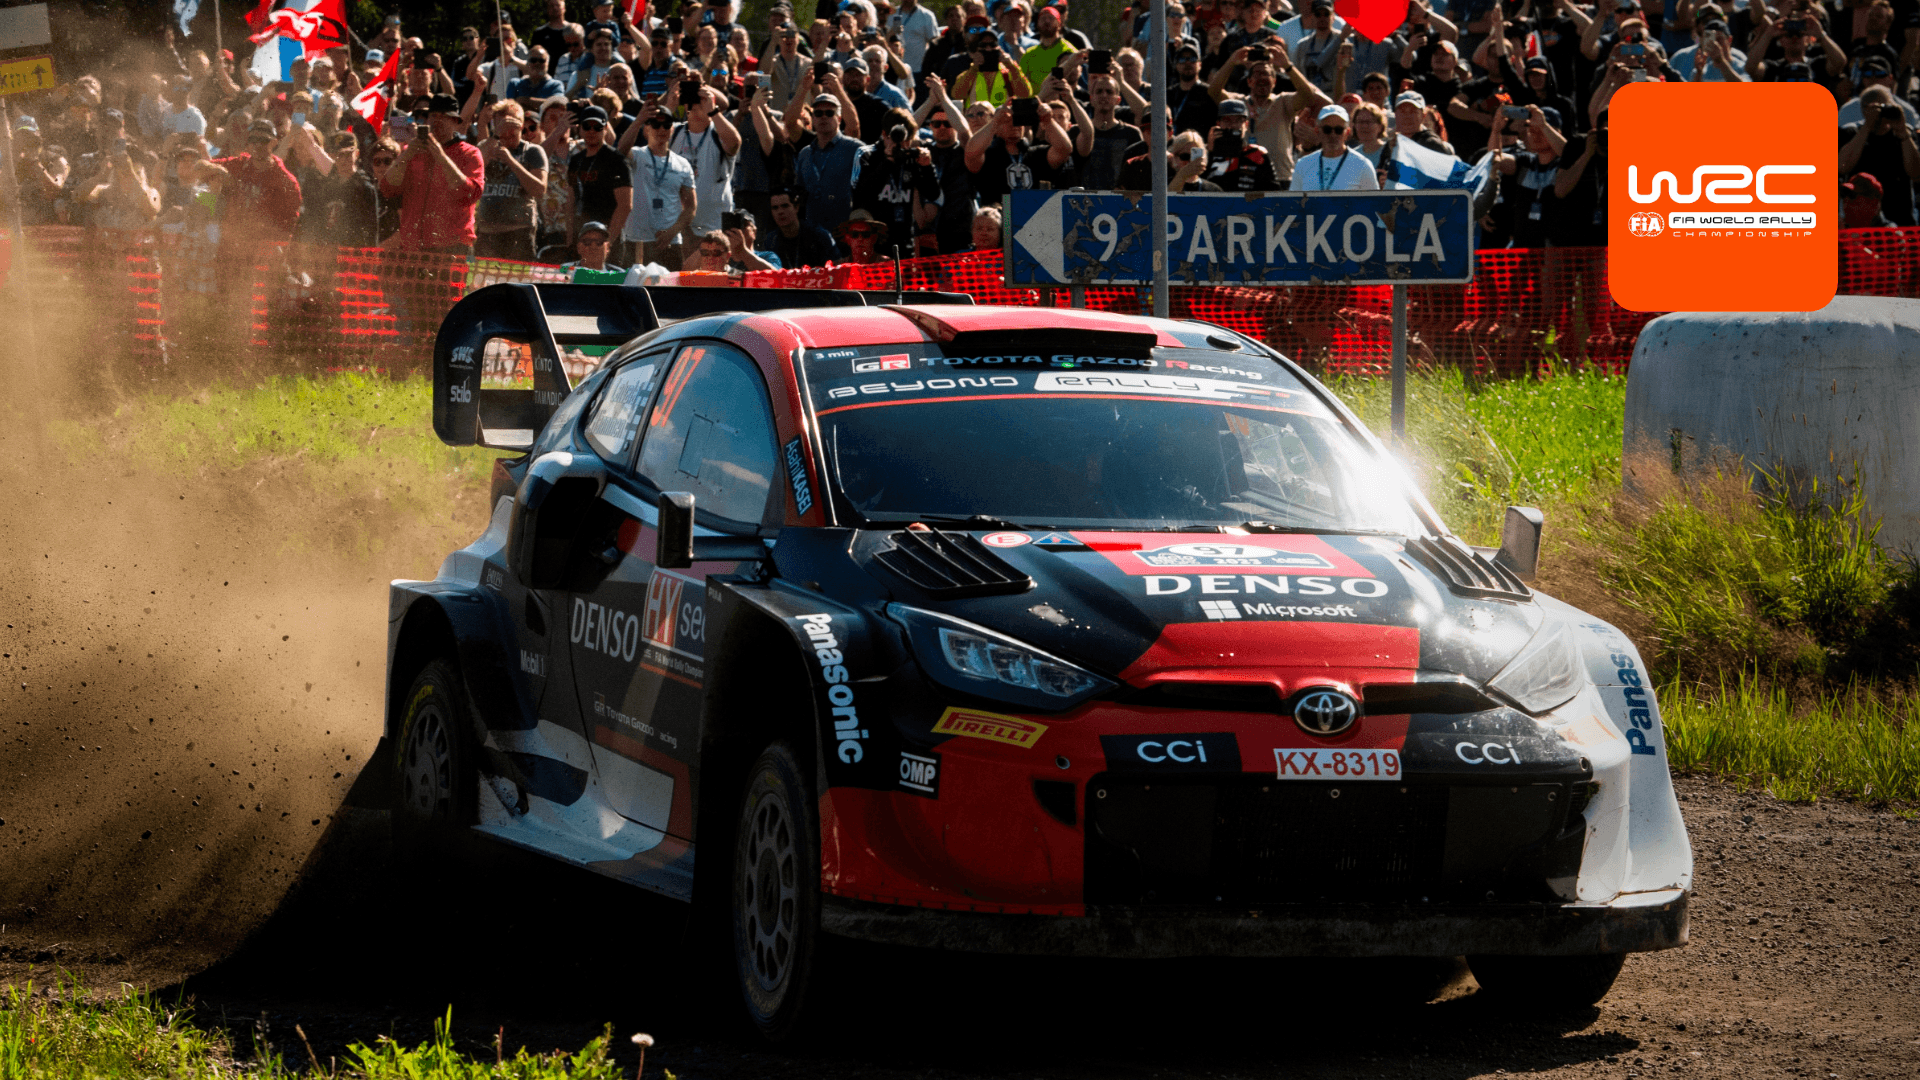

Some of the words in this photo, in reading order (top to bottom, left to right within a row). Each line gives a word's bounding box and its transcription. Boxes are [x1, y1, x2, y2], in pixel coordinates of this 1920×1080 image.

[1092, 213, 1118, 262] 9
[1167, 212, 1446, 264] PARKKOLA
[451, 346, 475, 366] SWS
[815, 352, 825, 360] 3
[828, 350, 854, 358] min
[855, 357, 911, 372] GR
[919, 355, 1042, 366] TOYOTA
[1050, 355, 1158, 368] GAZOO
[1165, 359, 1262, 380] Racing
[450, 376, 471, 403] Stilo
[651, 346, 706, 428] 97
[828, 376, 1019, 399] BEYOND
[1055, 376, 1200, 391] RALLY
[1190, 545, 1248, 557] 97
[1143, 575, 1388, 598] DENSO
[1243, 601, 1357, 619] Microsoft
[570, 597, 639, 662] DENSO
[520, 649, 540, 676] Mobil
[795, 613, 869, 764] Panasonic
[606, 705, 631, 726] TOYOTA
[631, 717, 655, 737] GAZOO
[660, 731, 677, 749] acing
[941, 710, 1038, 744] PIRELLI
[900, 758, 936, 786] OMP
[1277, 750, 1400, 777] KX-8319
